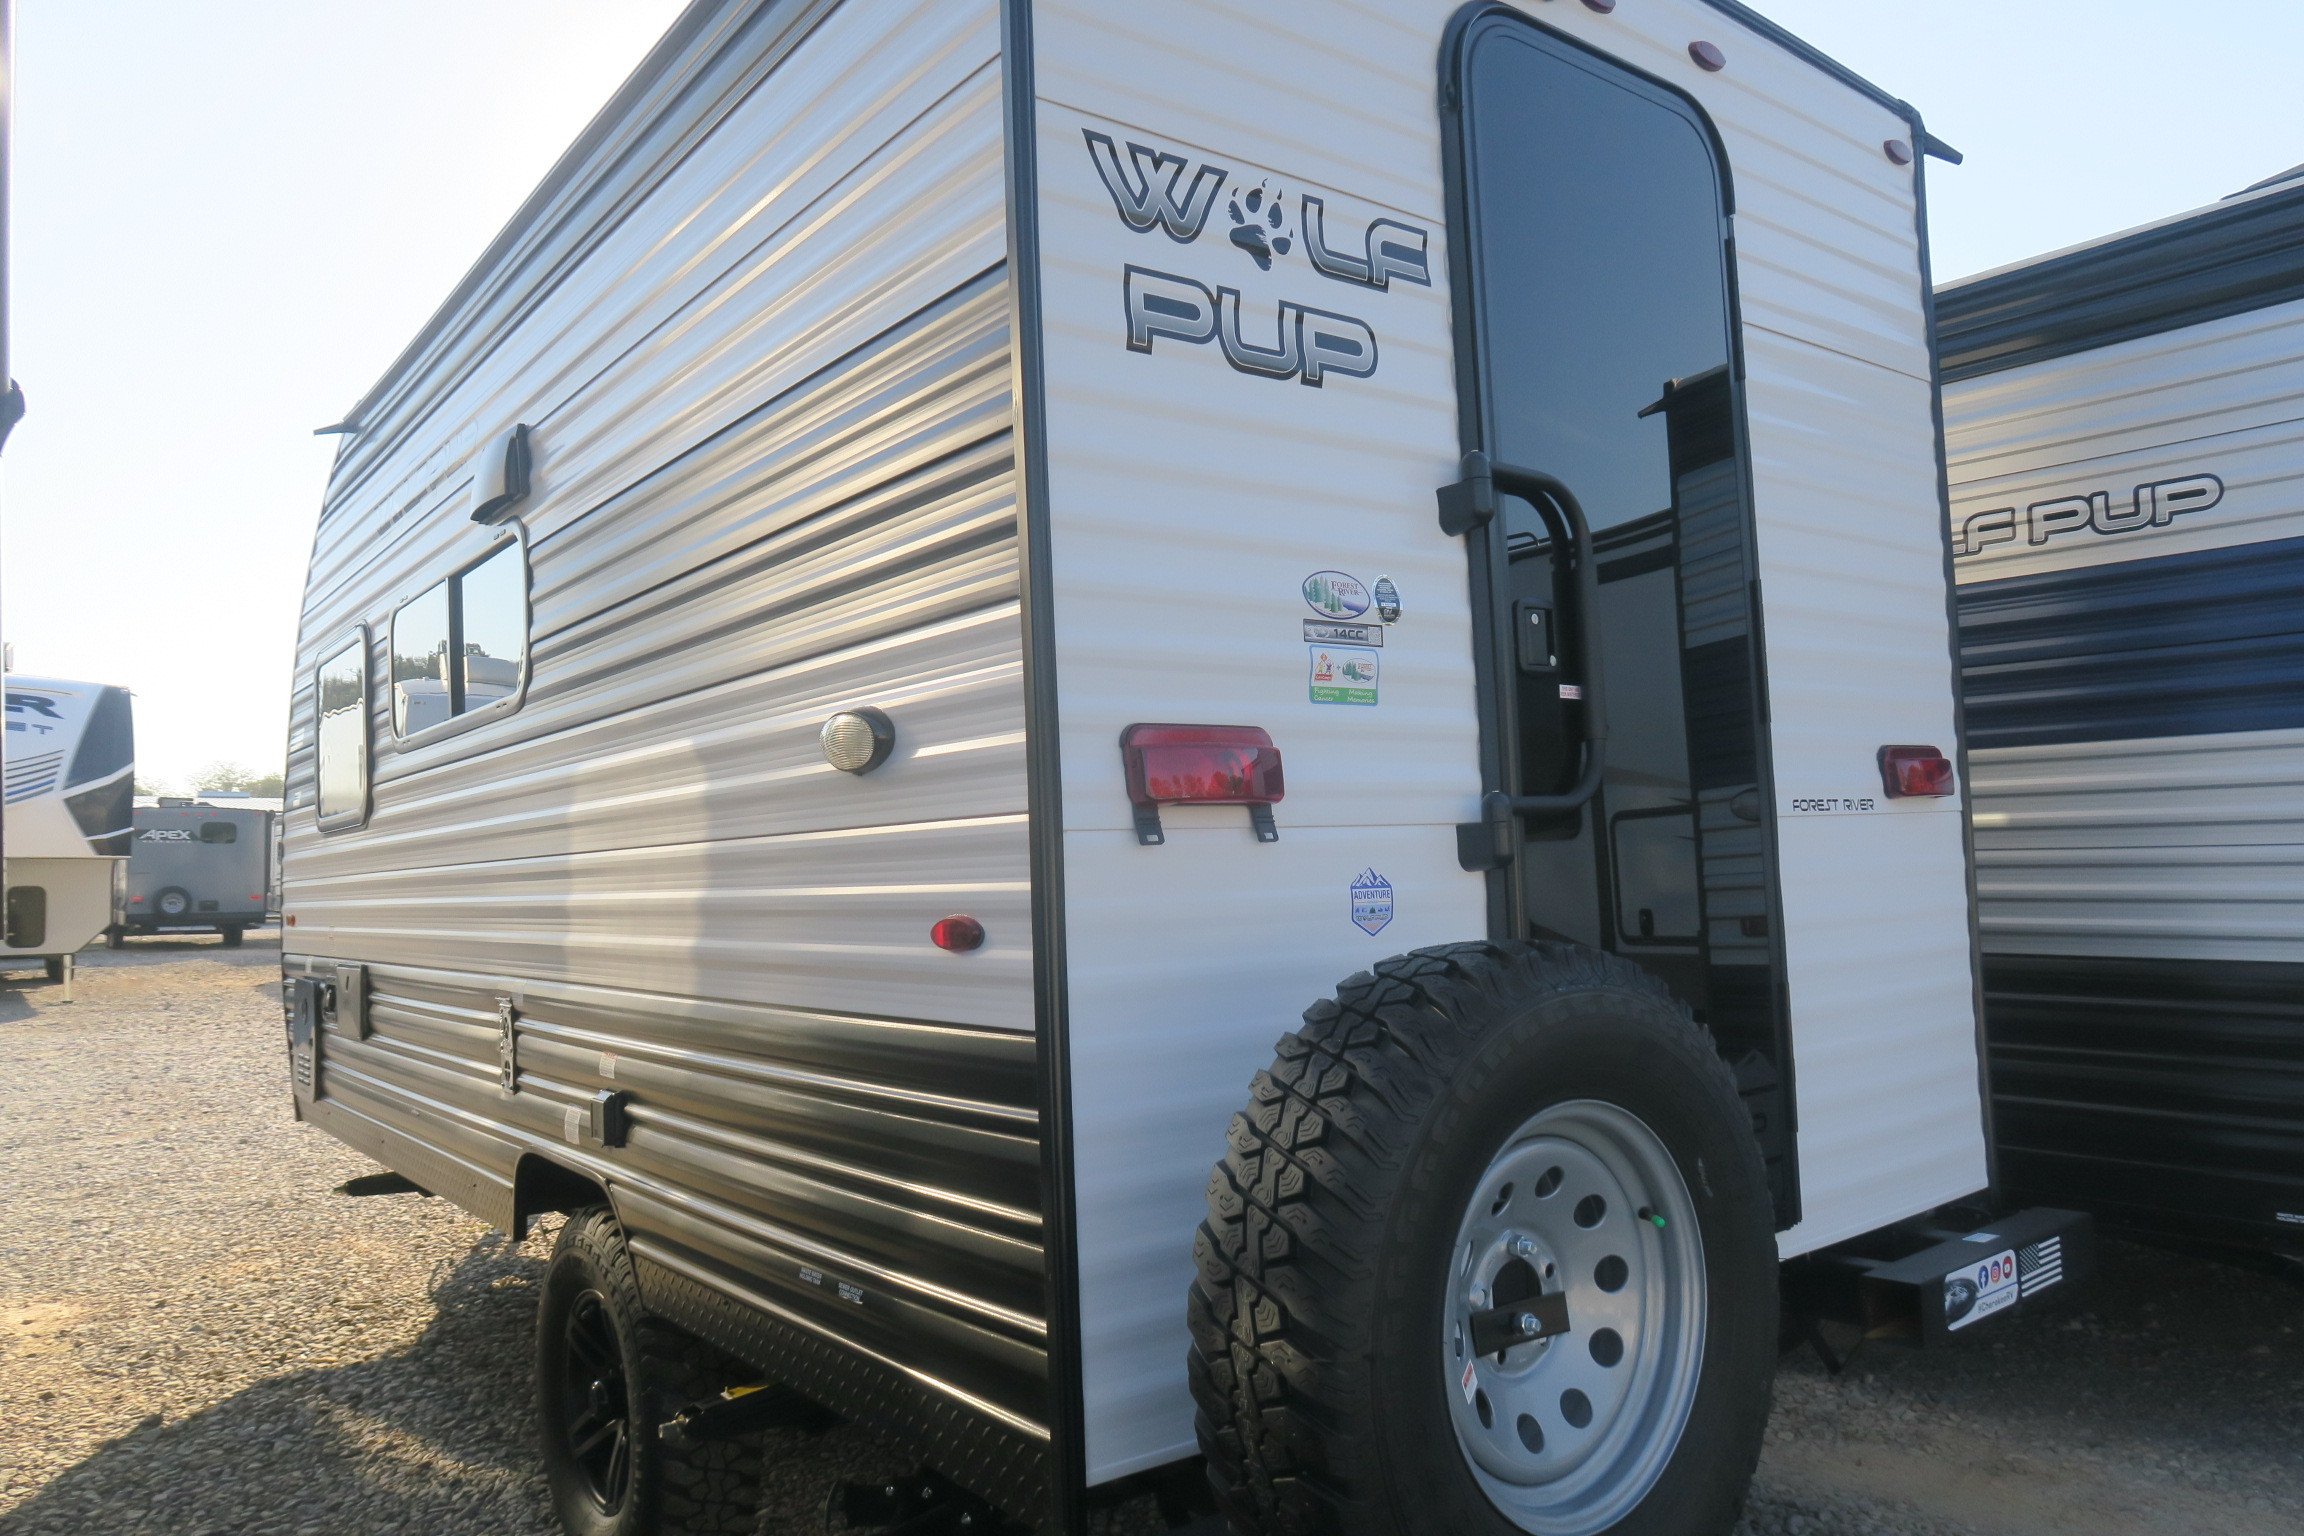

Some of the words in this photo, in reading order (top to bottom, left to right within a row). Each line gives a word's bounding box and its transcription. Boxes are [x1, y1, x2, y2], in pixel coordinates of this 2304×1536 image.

[1123, 262, 1378, 389] PUP
[1953, 507, 2016, 556] F
[2027, 473, 2224, 546] PUP
[1331, 580, 1359, 590] FOREST
[1337, 587, 1360, 597] RIVER
[1333, 628, 1364, 640] 14CC
[1792, 799, 1838, 812] FOREST
[1843, 798, 1875, 811] RIVER
[138, 829, 191, 840] APEX
[1353, 889, 1391, 900] ADVENTURE
